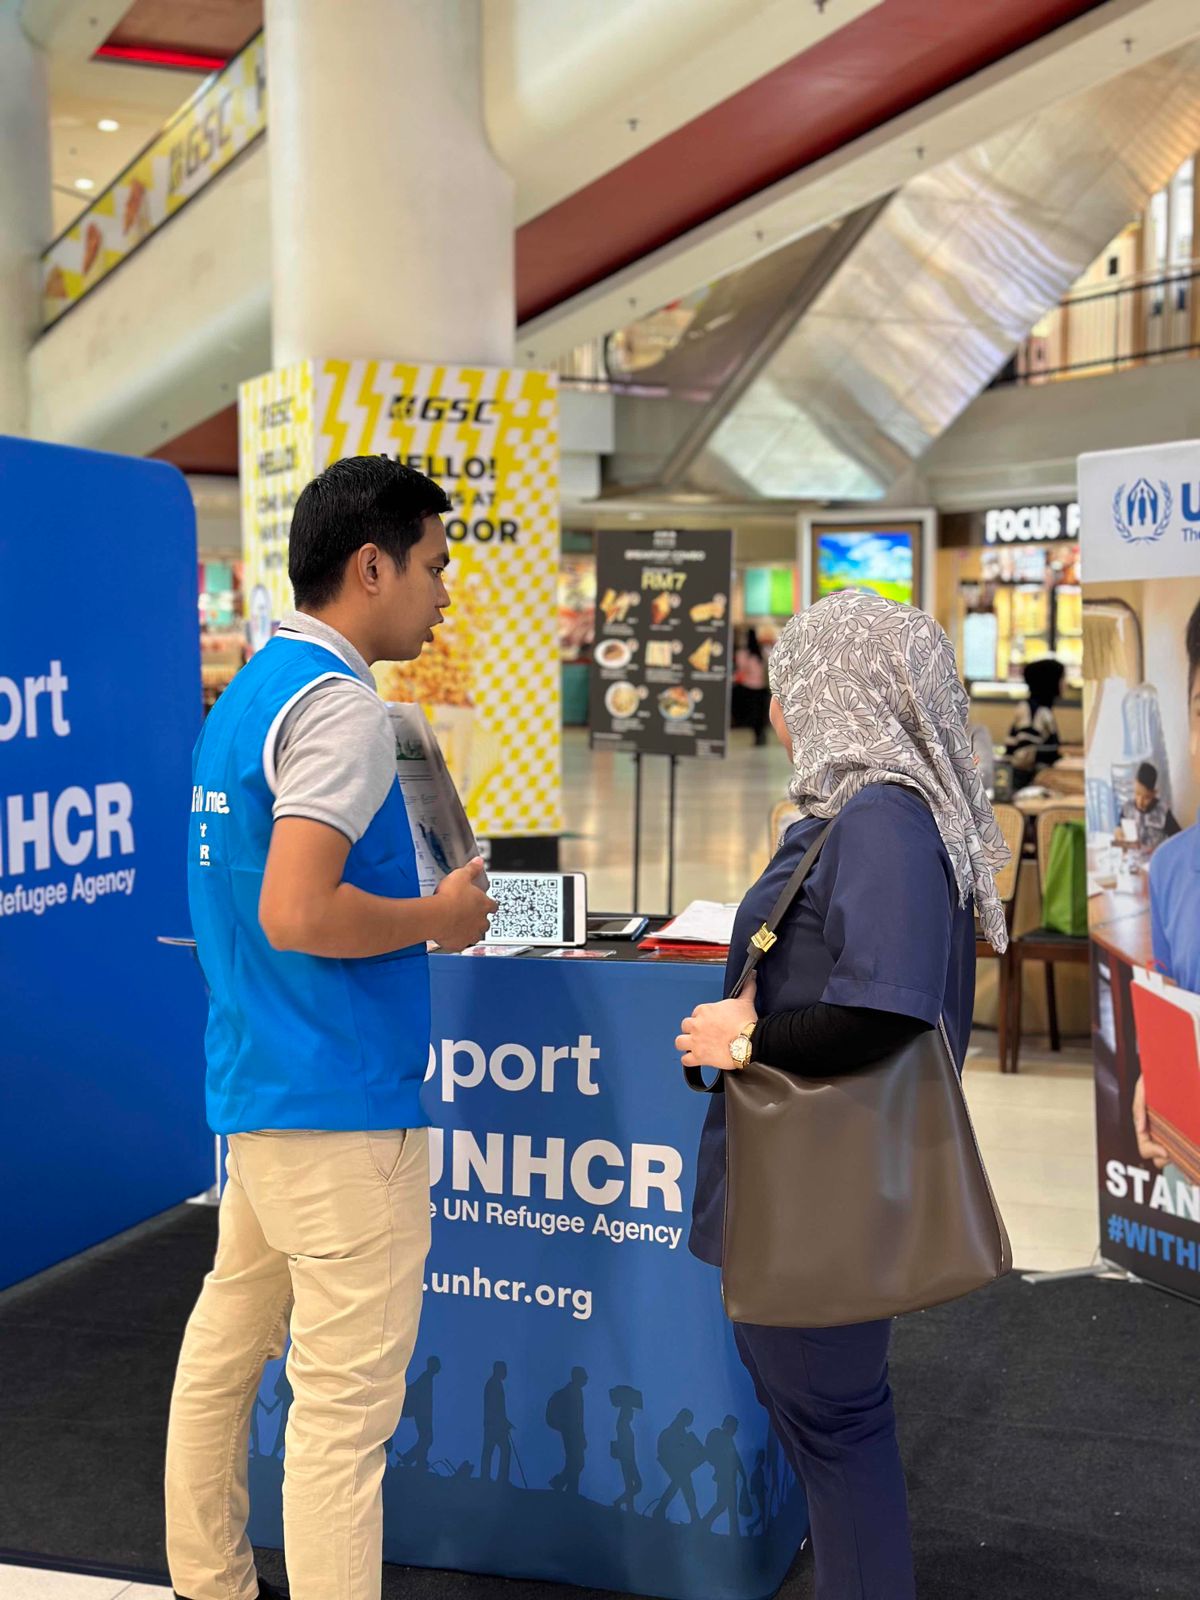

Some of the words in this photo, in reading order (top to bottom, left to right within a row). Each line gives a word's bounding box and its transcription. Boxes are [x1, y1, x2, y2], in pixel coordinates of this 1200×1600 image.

[420, 396, 498, 425] GSC
[396, 454, 497, 479] ELLO!
[985, 505, 1061, 543] FOCUS
[1182, 526, 1200, 542] Th
[0, 781, 135, 878] HCR
[0, 884, 68, 916] efugee
[71, 868, 136, 904] Agency
[424, 1034, 601, 1103] port
[443, 1197, 479, 1223] UN
[486, 1201, 585, 1236] Refugee
[592, 1213, 683, 1250] Agency
[1107, 1213, 1200, 1273] #WITH
